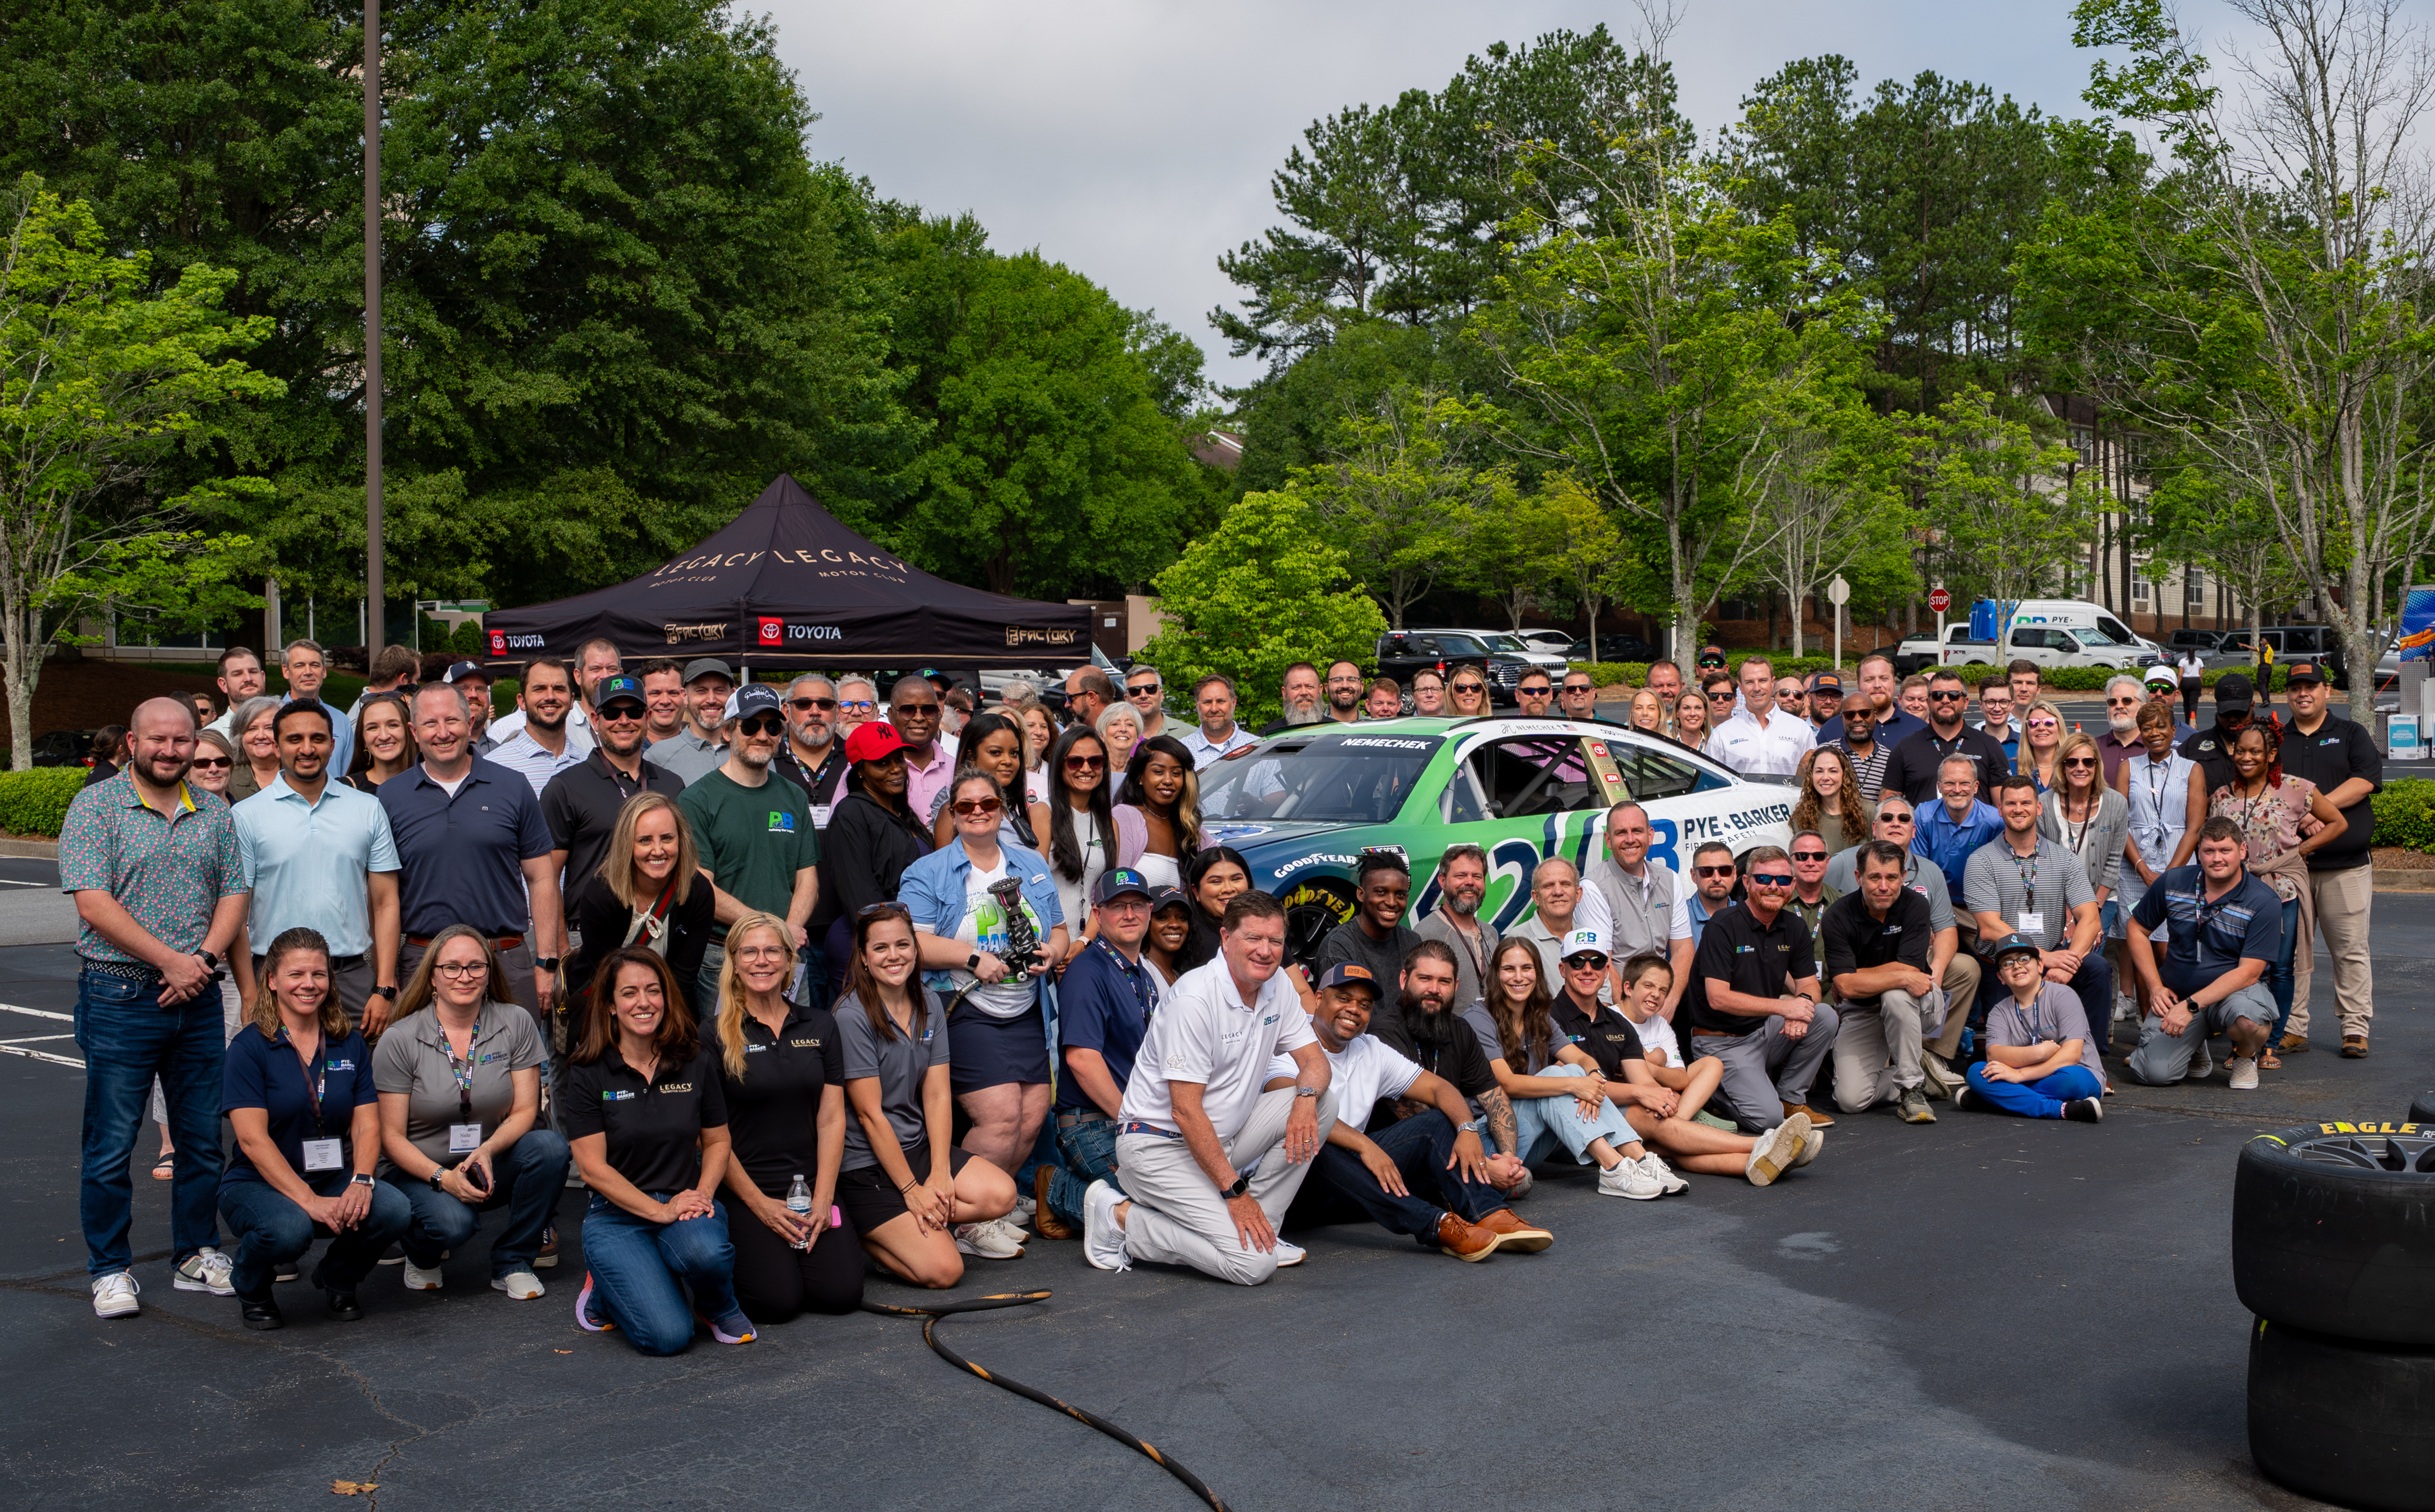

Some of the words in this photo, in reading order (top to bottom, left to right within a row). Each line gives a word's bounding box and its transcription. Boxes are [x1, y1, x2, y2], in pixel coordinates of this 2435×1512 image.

[654, 551, 765, 576] LEGACY
[773, 549, 908, 574] LEGACY
[874, 573, 905, 583] CLUB
[1931, 595, 1948, 605] STOP
[676, 623, 727, 642] FACTORY
[788, 625, 841, 640] TOYOTA
[1019, 627, 1077, 644] FACTORY
[507, 634, 544, 648] TOYOTA
[877, 724, 893, 739] NY
[1340, 738, 1432, 750] NEMECHEK
[1684, 816, 1724, 840] PYE
[1729, 804, 1791, 830] BARKER
[1719, 830, 1757, 845] SAFETY
[1222, 1031, 1243, 1040] LEGACY
[1167, 1055, 1186, 1069] 42
